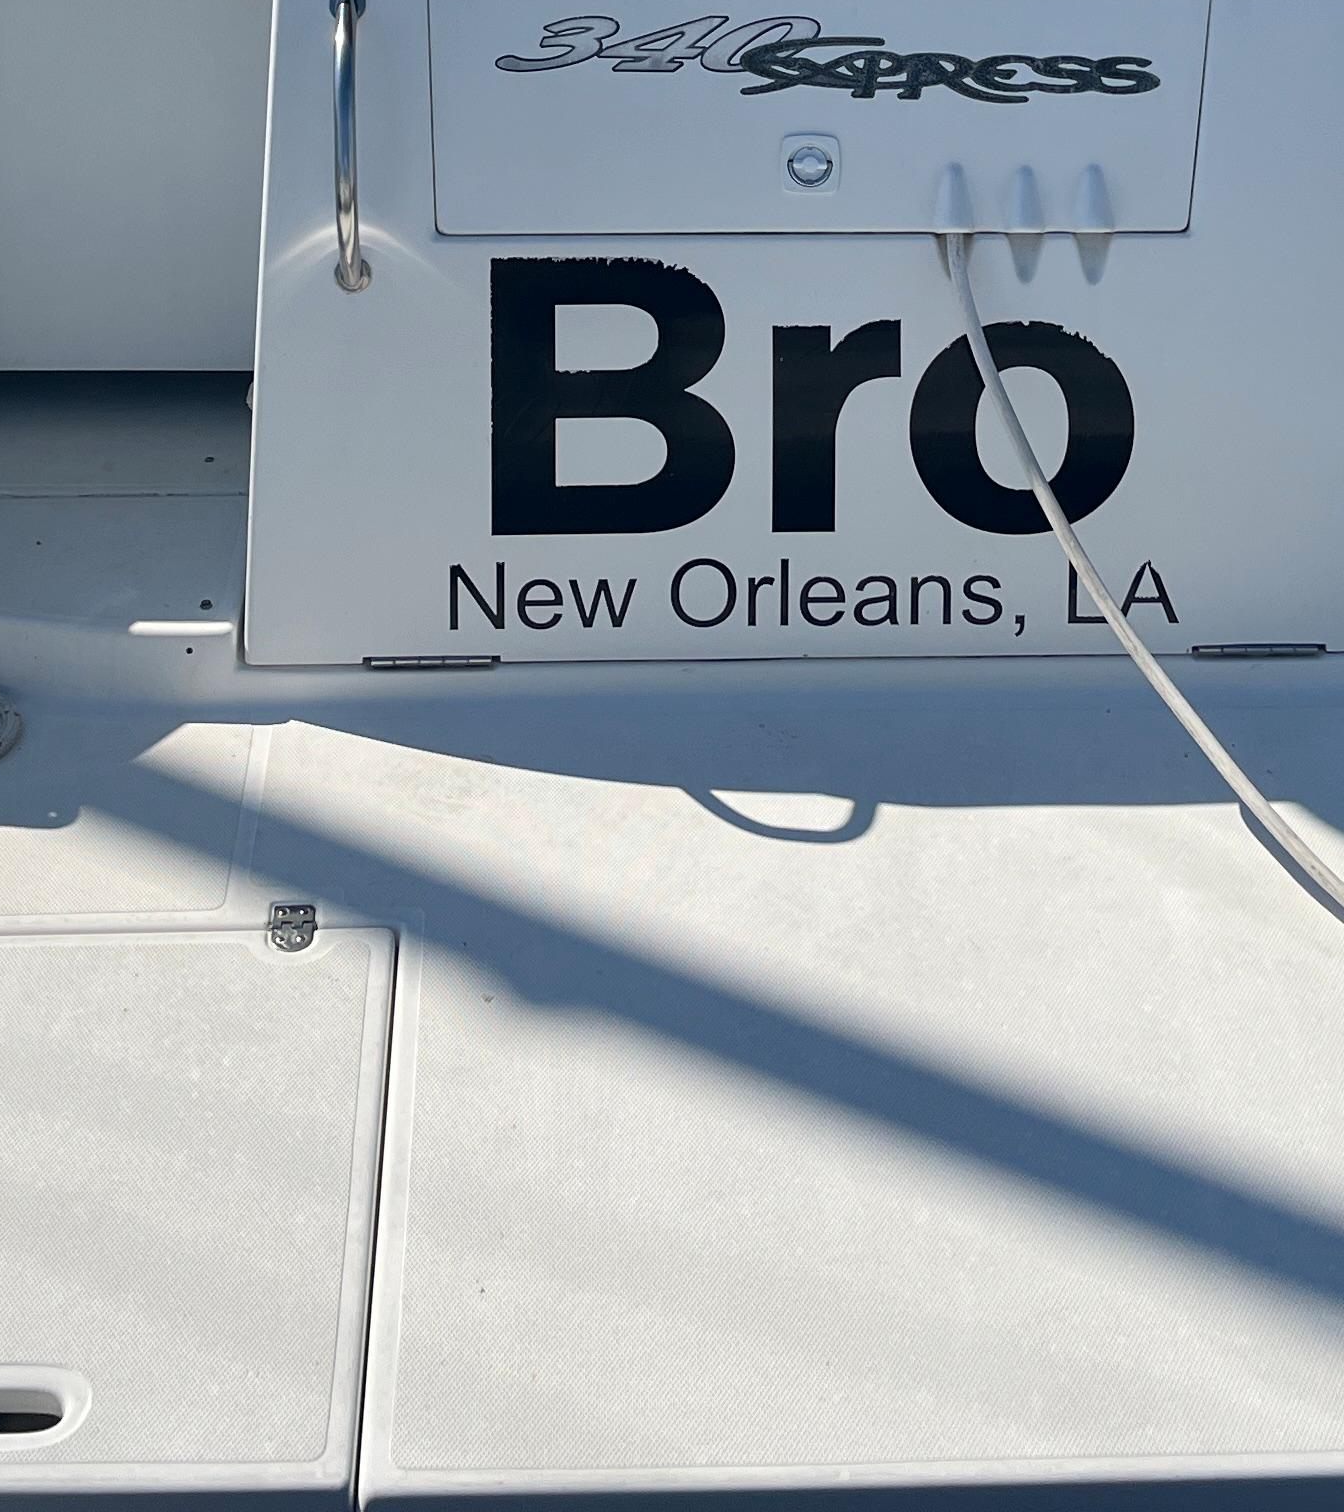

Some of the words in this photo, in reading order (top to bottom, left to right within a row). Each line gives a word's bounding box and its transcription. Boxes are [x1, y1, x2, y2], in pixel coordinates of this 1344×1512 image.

[494, 14, 822, 74] 340
[490, 256, 1136, 536] Bro
[449, 560, 638, 631] New
[669, 558, 1026, 638] Orleans,
[1067, 558, 1180, 625] LA
